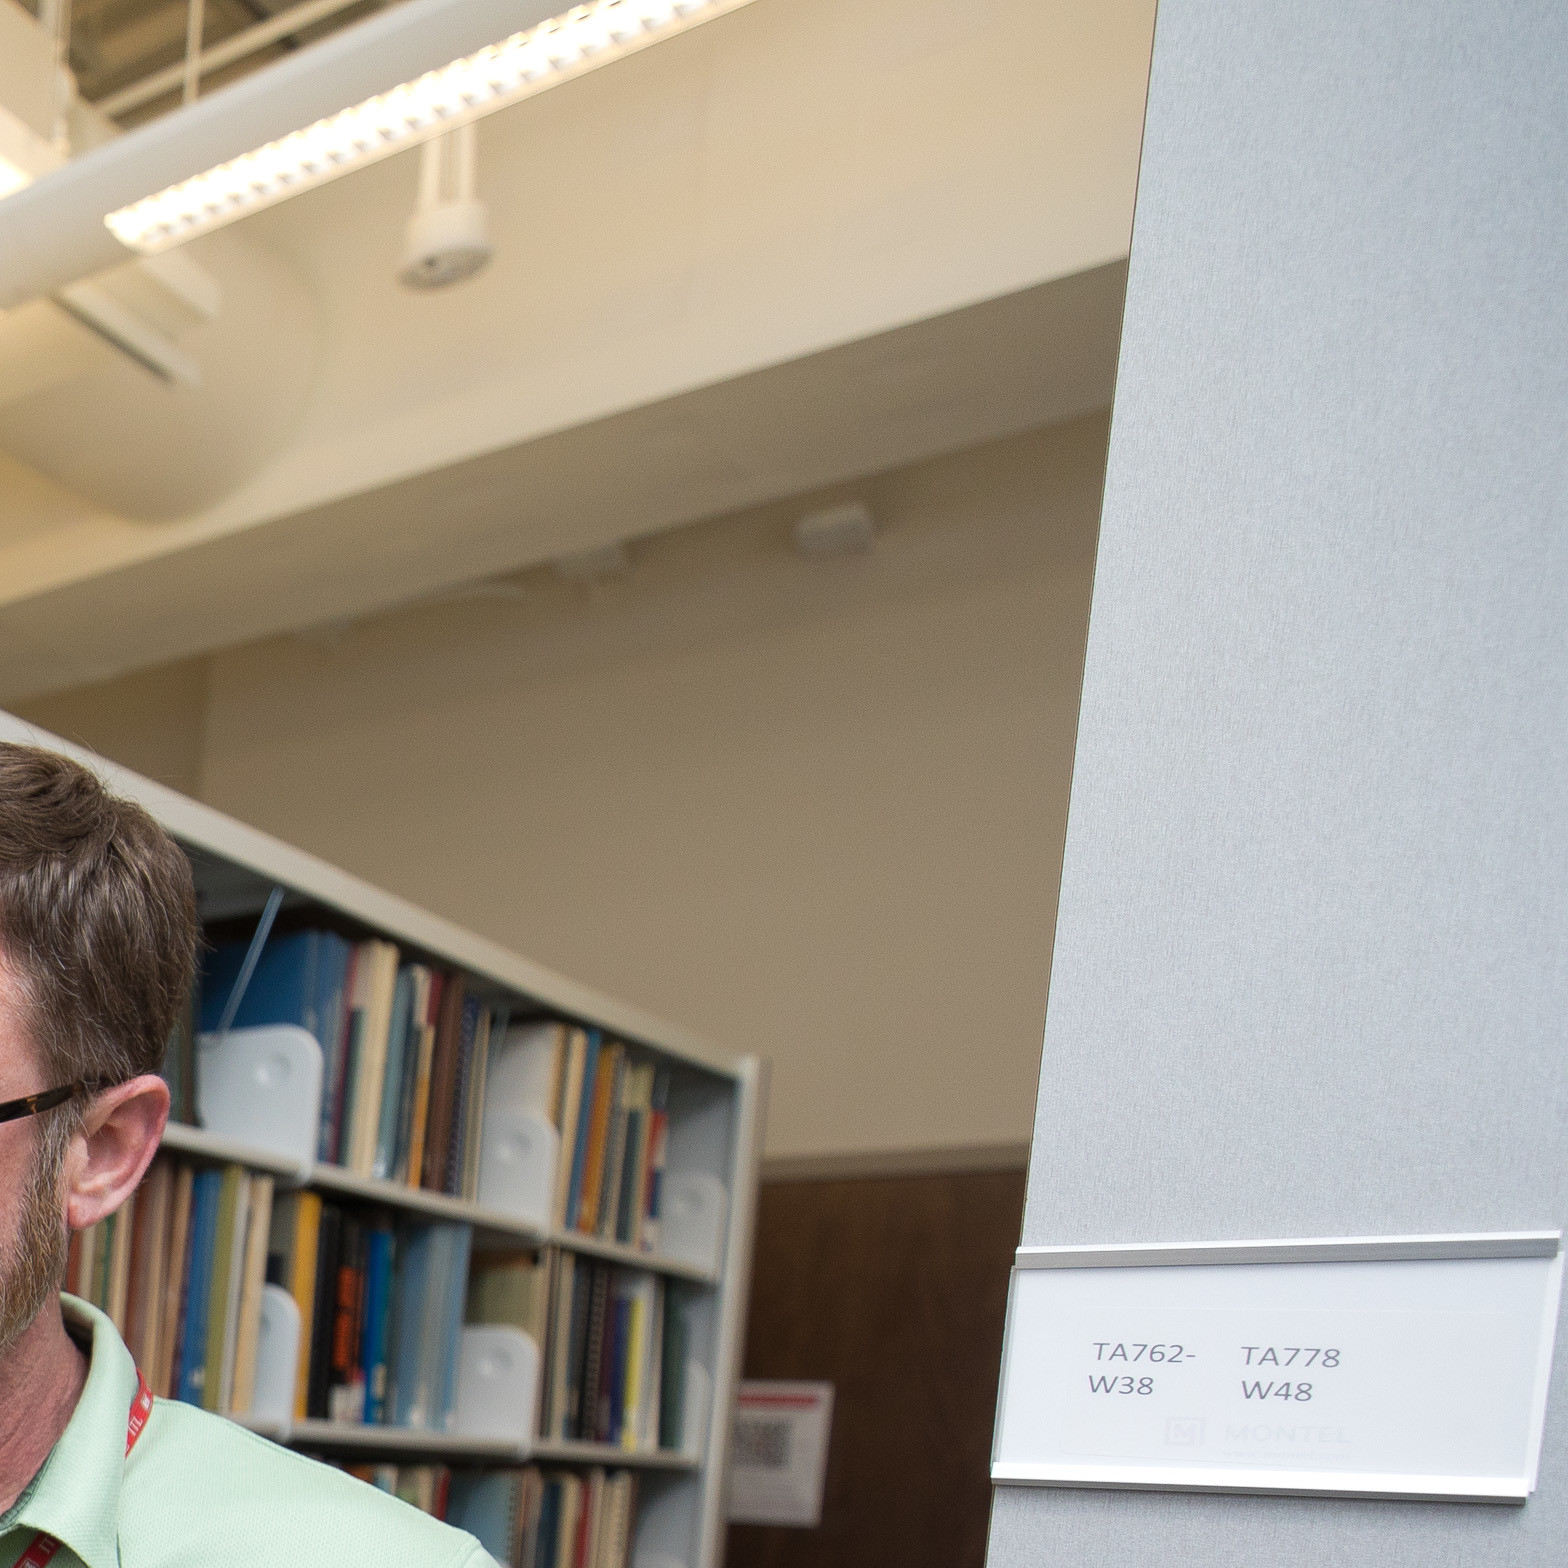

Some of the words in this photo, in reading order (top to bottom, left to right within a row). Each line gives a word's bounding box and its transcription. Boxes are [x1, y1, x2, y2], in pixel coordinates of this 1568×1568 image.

[1092, 1342, 1196, 1364] TA762-
[1241, 1346, 1341, 1368] TA778
[1088, 1374, 1154, 1396] W38
[1241, 1379, 1313, 1402] W48
[128, 1416, 144, 1436] ITL
[1224, 1424, 1351, 1445] MONTEL
[38, 1535, 57, 1554] IT
